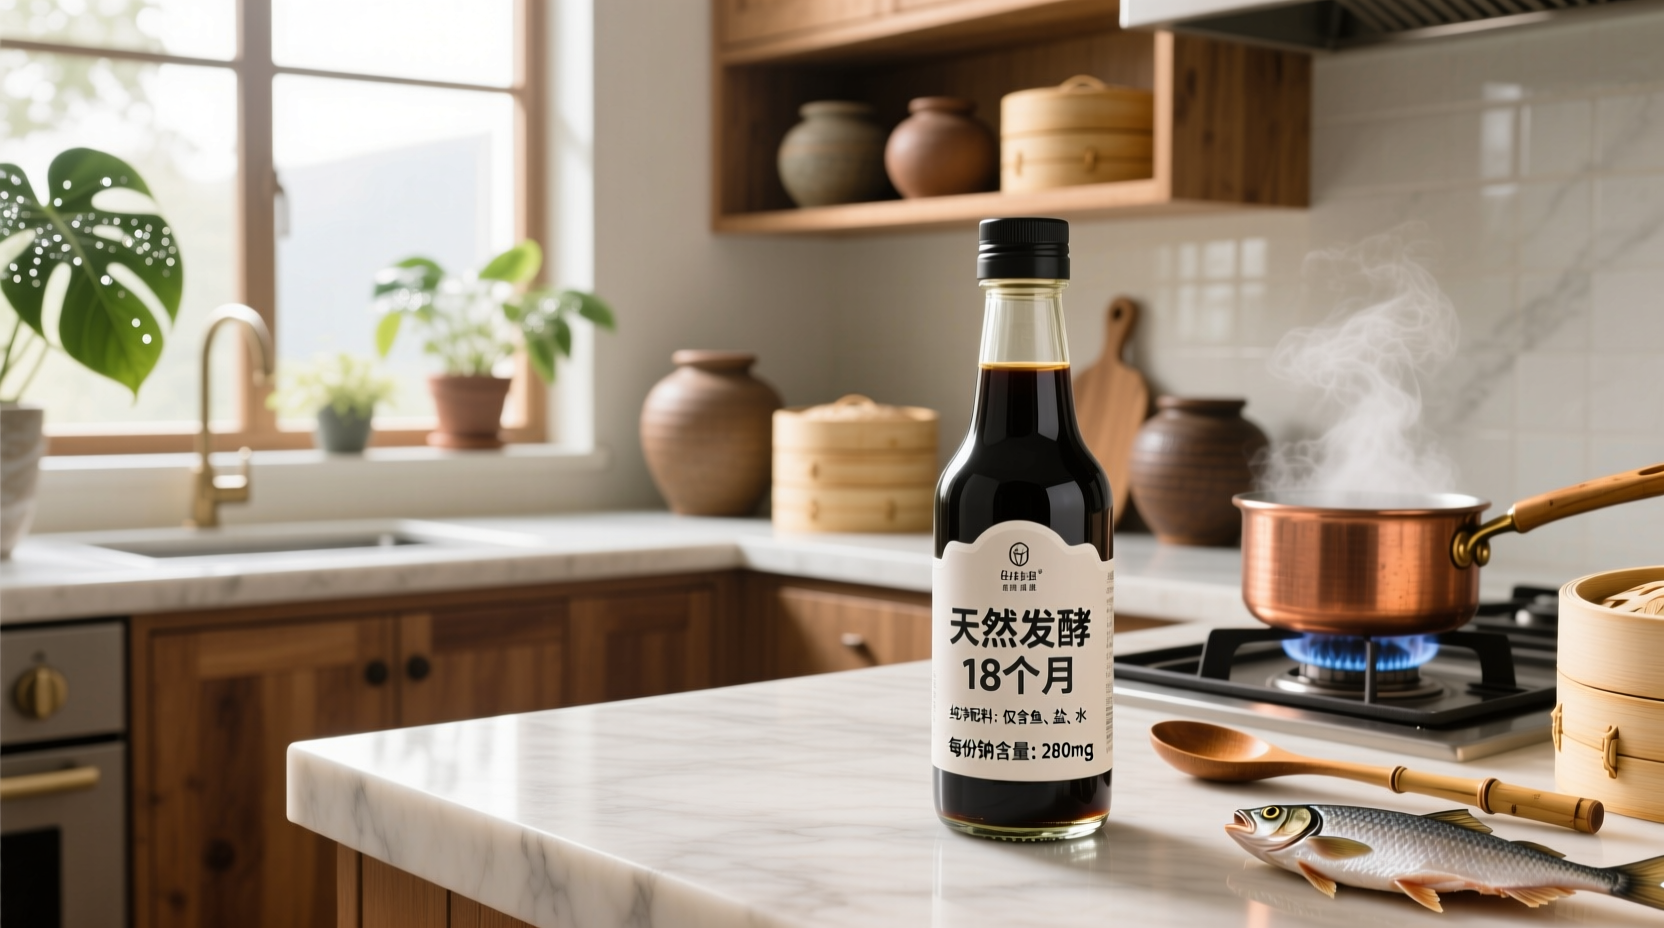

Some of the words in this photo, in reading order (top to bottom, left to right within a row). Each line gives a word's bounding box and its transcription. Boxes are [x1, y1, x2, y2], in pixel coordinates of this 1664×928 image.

[950, 607, 1091, 649] 天然发酵
[962, 655, 1073, 696] 18个月
